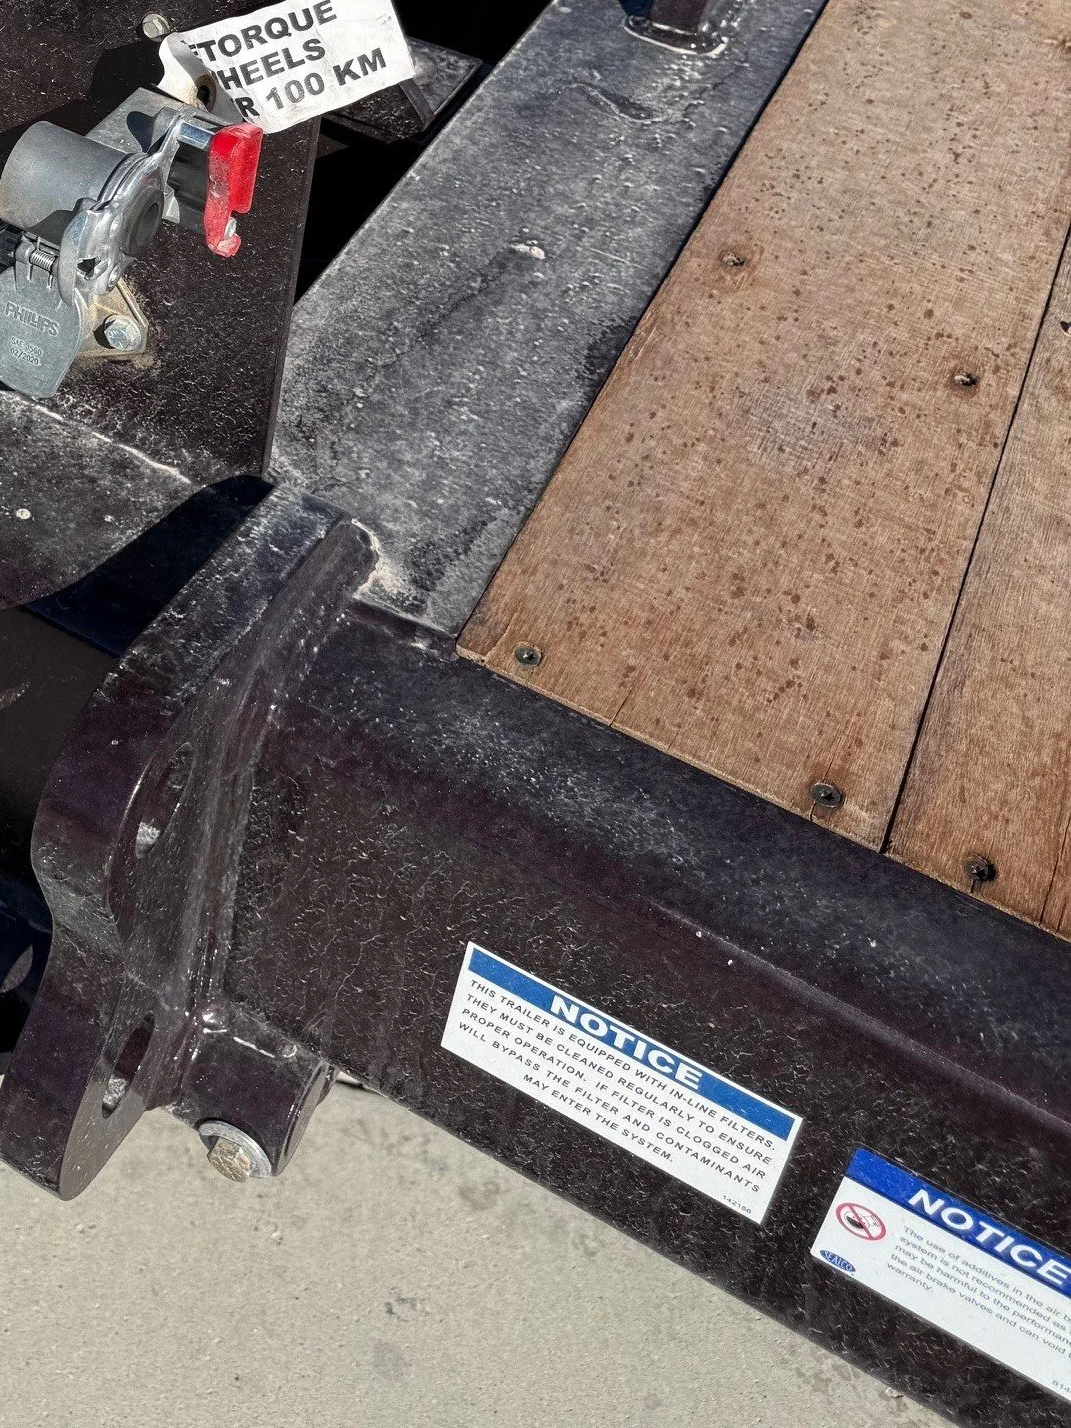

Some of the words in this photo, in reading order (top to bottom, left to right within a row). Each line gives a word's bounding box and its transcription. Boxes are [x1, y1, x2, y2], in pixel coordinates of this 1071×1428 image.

[216, 38, 326, 91] HEELS
[265, 72, 326, 111] 100
[332, 47, 387, 86] KM
[5, 301, 59, 336] PHILLIPS
[10, 347, 40, 366] 02/2020
[467, 993, 497, 1013] THEY
[499, 1012, 533, 1034] MUST
[536, 1033, 553, 1045] BE
[557, 1044, 614, 1079] CLEANED
[617, 1077, 694, 1122] REGULARLY
[698, 1120, 715, 1134] TO
[719, 1132, 772, 1165] ENSURE
[470, 979, 496, 998] THIS
[500, 996, 550, 1028] TRAILER
[553, 1025, 565, 1036] IS
[568, 1033, 631, 1071] EQUIPPED
[635, 1069, 667, 1090] WITH
[669, 1089, 717, 1118] IN-LINE
[720, 1116, 775, 1150] FILTERS.
[550, 994, 703, 1091] NOTICE
[459, 1021, 486, 1042] WILL
[492, 1041, 541, 1071] BYPASS
[546, 1070, 571, 1088] THE
[574, 1087, 619, 1115] FILTER
[623, 1114, 650, 1132] AND
[656, 1132, 760, 1193] CONTAMINANTS
[462, 1008, 511, 1039] PROPER
[514, 1037, 587, 1082] OPERATION.
[595, 1081, 608, 1091] IF
[611, 1090, 655, 1118] FILTER
[658, 1116, 671, 1127] IS
[676, 1126, 739, 1164] CLOGGED
[742, 1163, 766, 1179] AIR
[523, 1074, 549, 1091] MAY
[551, 1089, 591, 1115] ENTER
[595, 1113, 619, 1130] THE
[621, 1129, 673, 1162] SYSTEM.
[823, 1250, 855, 1272] SEALCO
[887, 1263, 934, 1293] warranty.
[895, 1245, 918, 1260] may
[920, 1258, 934, 1270] be
[936, 1267, 978, 1293] harmful
[980, 1290, 990, 1301] to
[992, 1297, 1010, 1311] the
[903, 1225, 924, 1241] The
[926, 1240, 946, 1254] use
[948, 1252, 960, 1261] of
[961, 1259, 1010, 1289] additives
[1012, 1286, 1023, 1296] in
[1025, 1293, 1044, 1307] the
[1046, 1305, 1062, 1316] air
[907, 1188, 1071, 1286] NOTICE
[891, 1253, 908, 1267] the
[909, 1264, 926, 1276] air
[925, 1273, 956, 1294] brake
[959, 1292, 993, 1315] valves
[995, 1312, 1018, 1328] and
[1019, 1326, 1040, 1341] can
[1042, 1337, 1067, 1355] void
[899, 1236, 937, 1261] system
[940, 1257, 950, 1267] is
[952, 1265, 970, 1278] not
[971, 1277, 1051, 1322] recommended
[1052, 1321, 1067, 1331] as
